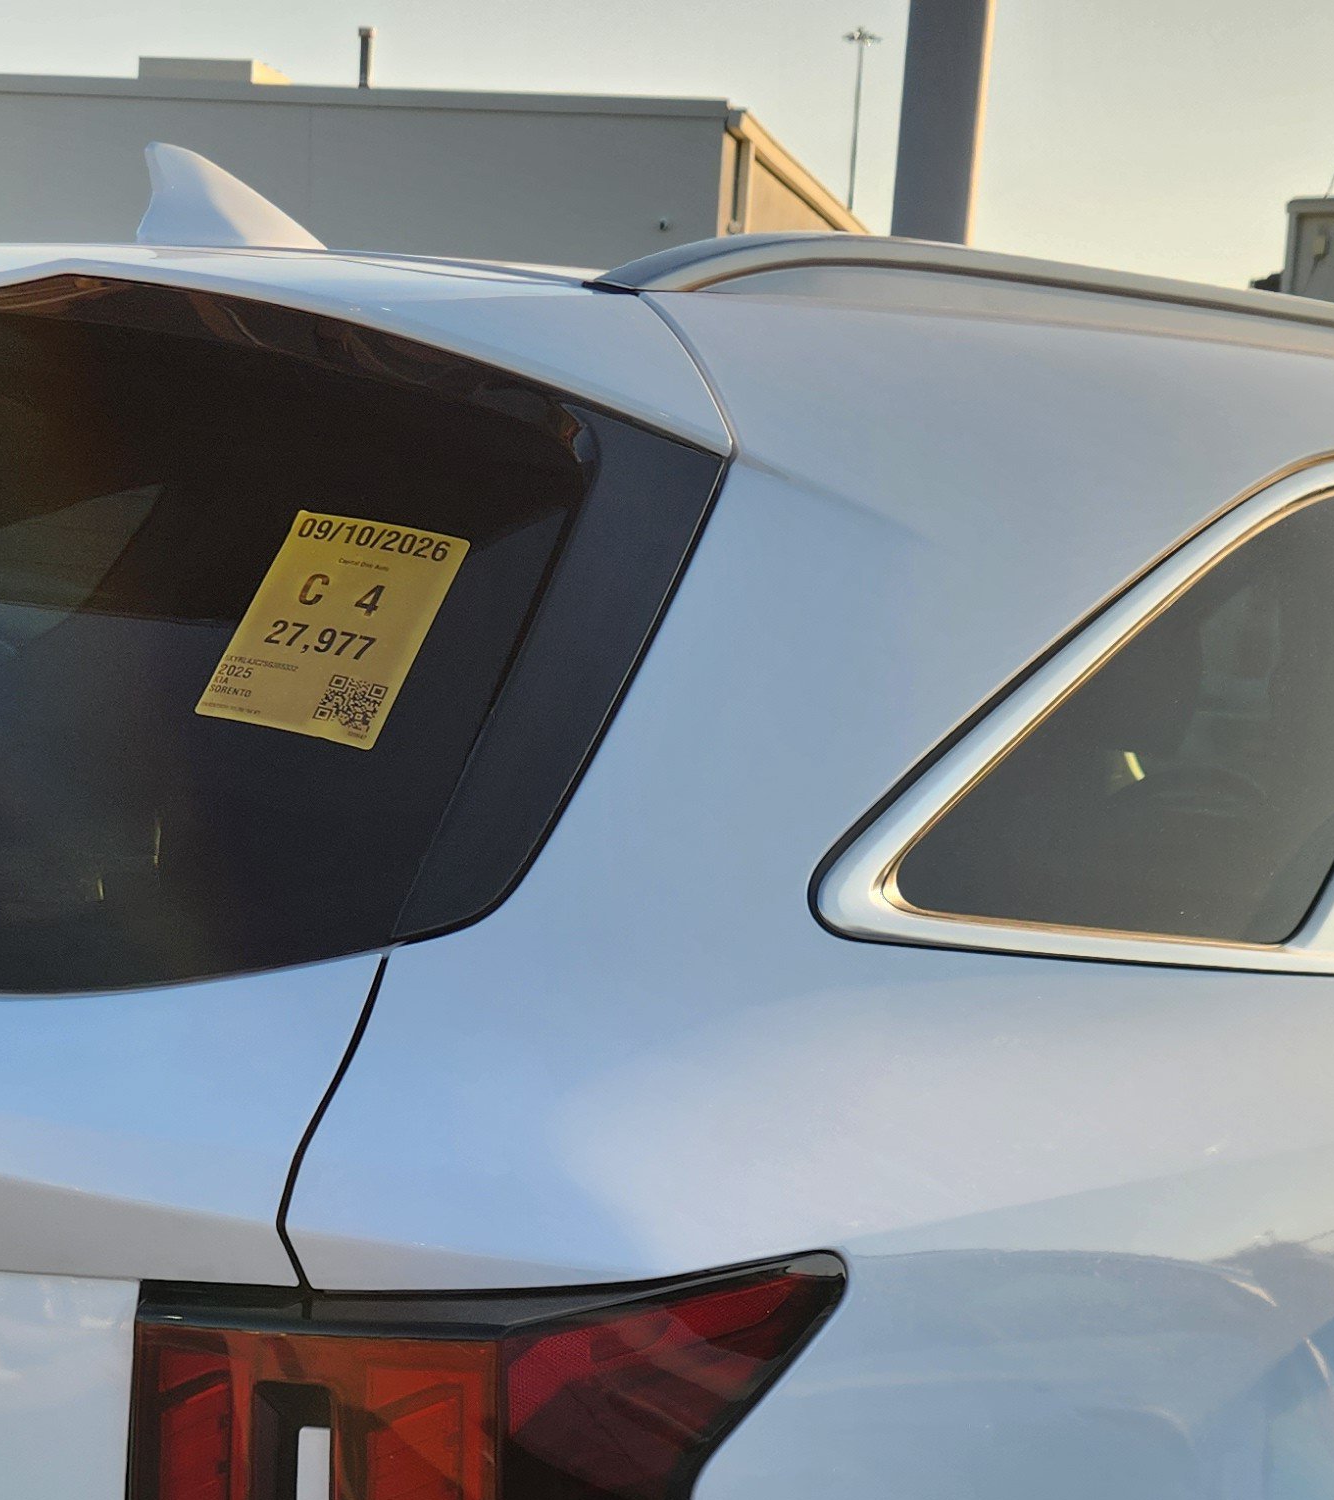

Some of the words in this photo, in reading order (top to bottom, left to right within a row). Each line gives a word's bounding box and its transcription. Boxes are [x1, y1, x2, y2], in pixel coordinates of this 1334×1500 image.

[298, 518, 451, 562] 09/10/2026
[298, 573, 330, 606] C
[354, 584, 386, 617] 4
[263, 619, 378, 661] 27,977
[217, 663, 254, 679] 2025
